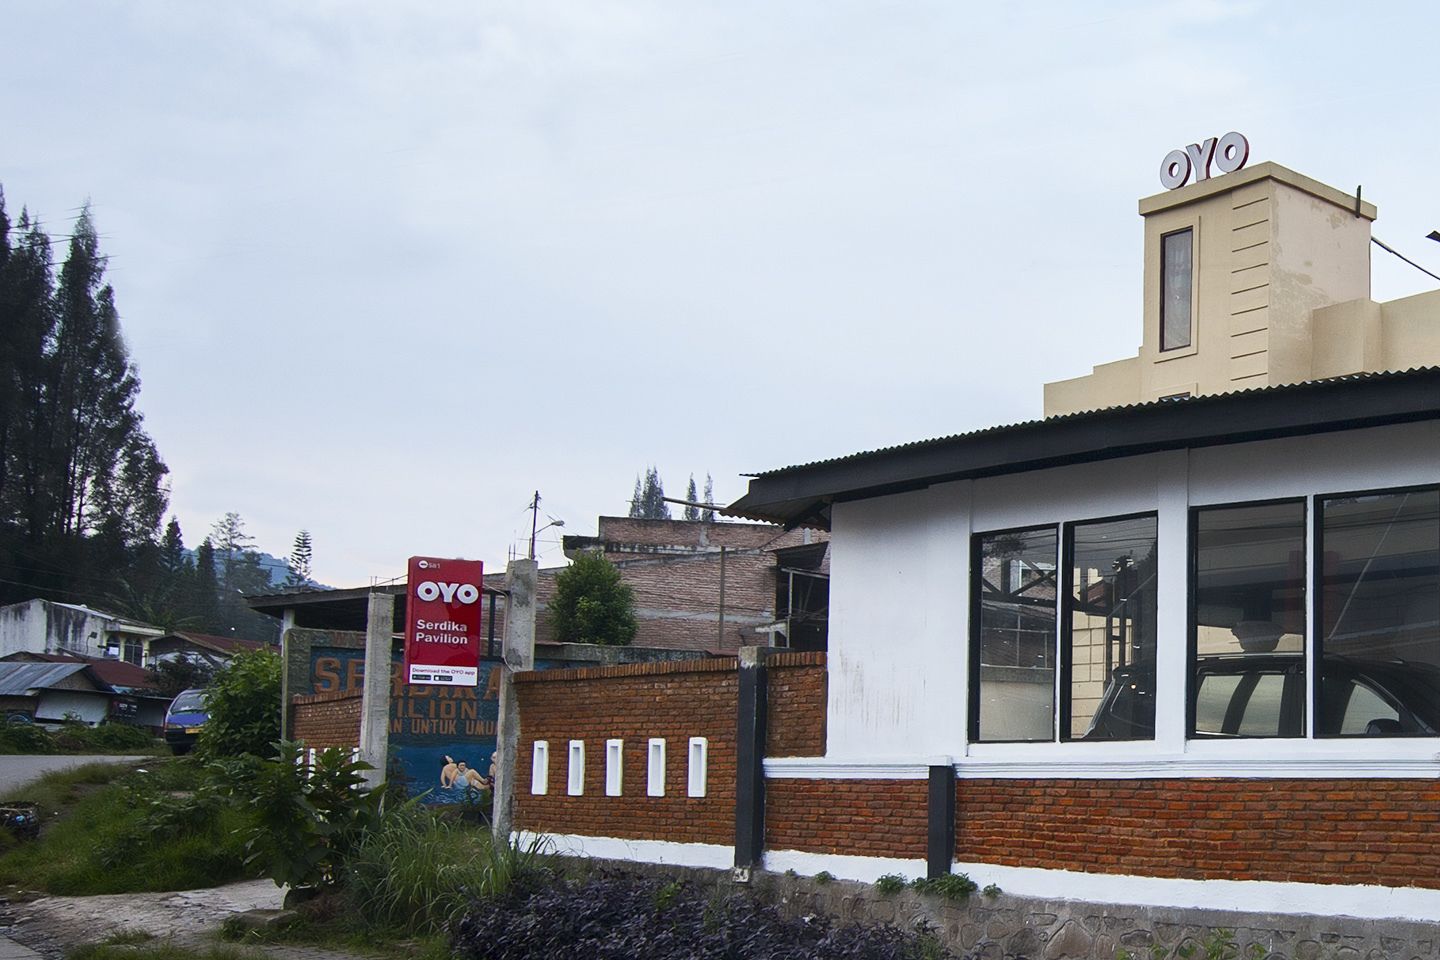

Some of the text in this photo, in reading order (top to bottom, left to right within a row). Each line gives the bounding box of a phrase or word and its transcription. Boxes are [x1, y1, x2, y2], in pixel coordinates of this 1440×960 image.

[1160, 131, 1250, 190] OYO
[417, 581, 479, 604] OYO
[416, 619, 468, 632] Serdika
[415, 632, 468, 645] Pavilion
